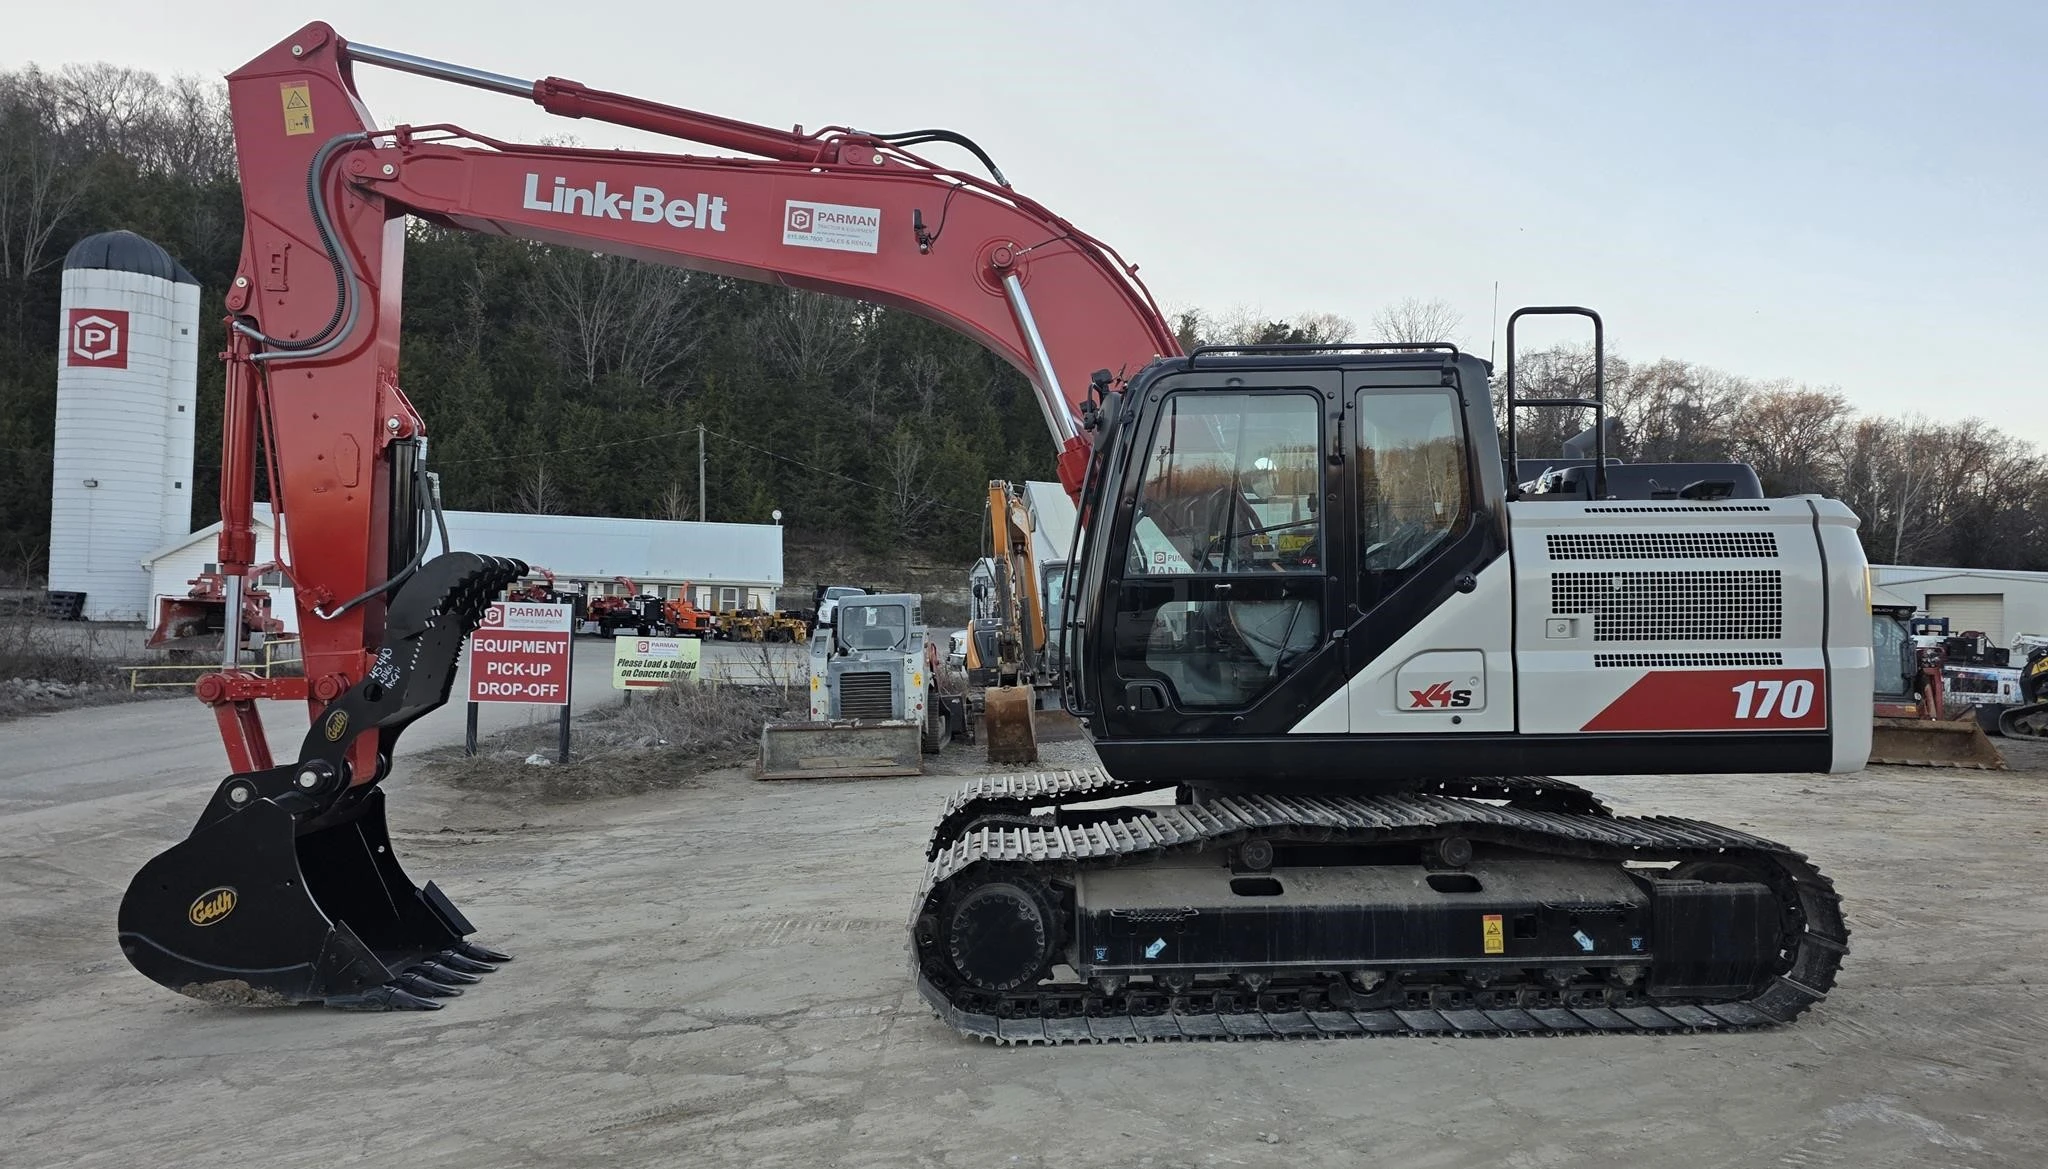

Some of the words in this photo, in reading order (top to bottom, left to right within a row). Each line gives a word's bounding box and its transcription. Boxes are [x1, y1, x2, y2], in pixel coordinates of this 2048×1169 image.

[523, 173, 728, 232] Link-Belt
[817, 212, 877, 227] PARMAN
[85, 329, 105, 347] P
[509, 607, 563, 618] PARMAN
[473, 639, 567, 654] EQUIPMENT
[487, 661, 552, 676] PICK-UP
[617, 658, 642, 668] Please
[643, 659, 662, 669] Load
[669, 660, 697, 670] Unload
[621, 669, 631, 677] on
[632, 668, 669, 679] Concrete
[477, 682, 559, 697] DROP-OFF
[1732, 679, 1815, 719] 170
